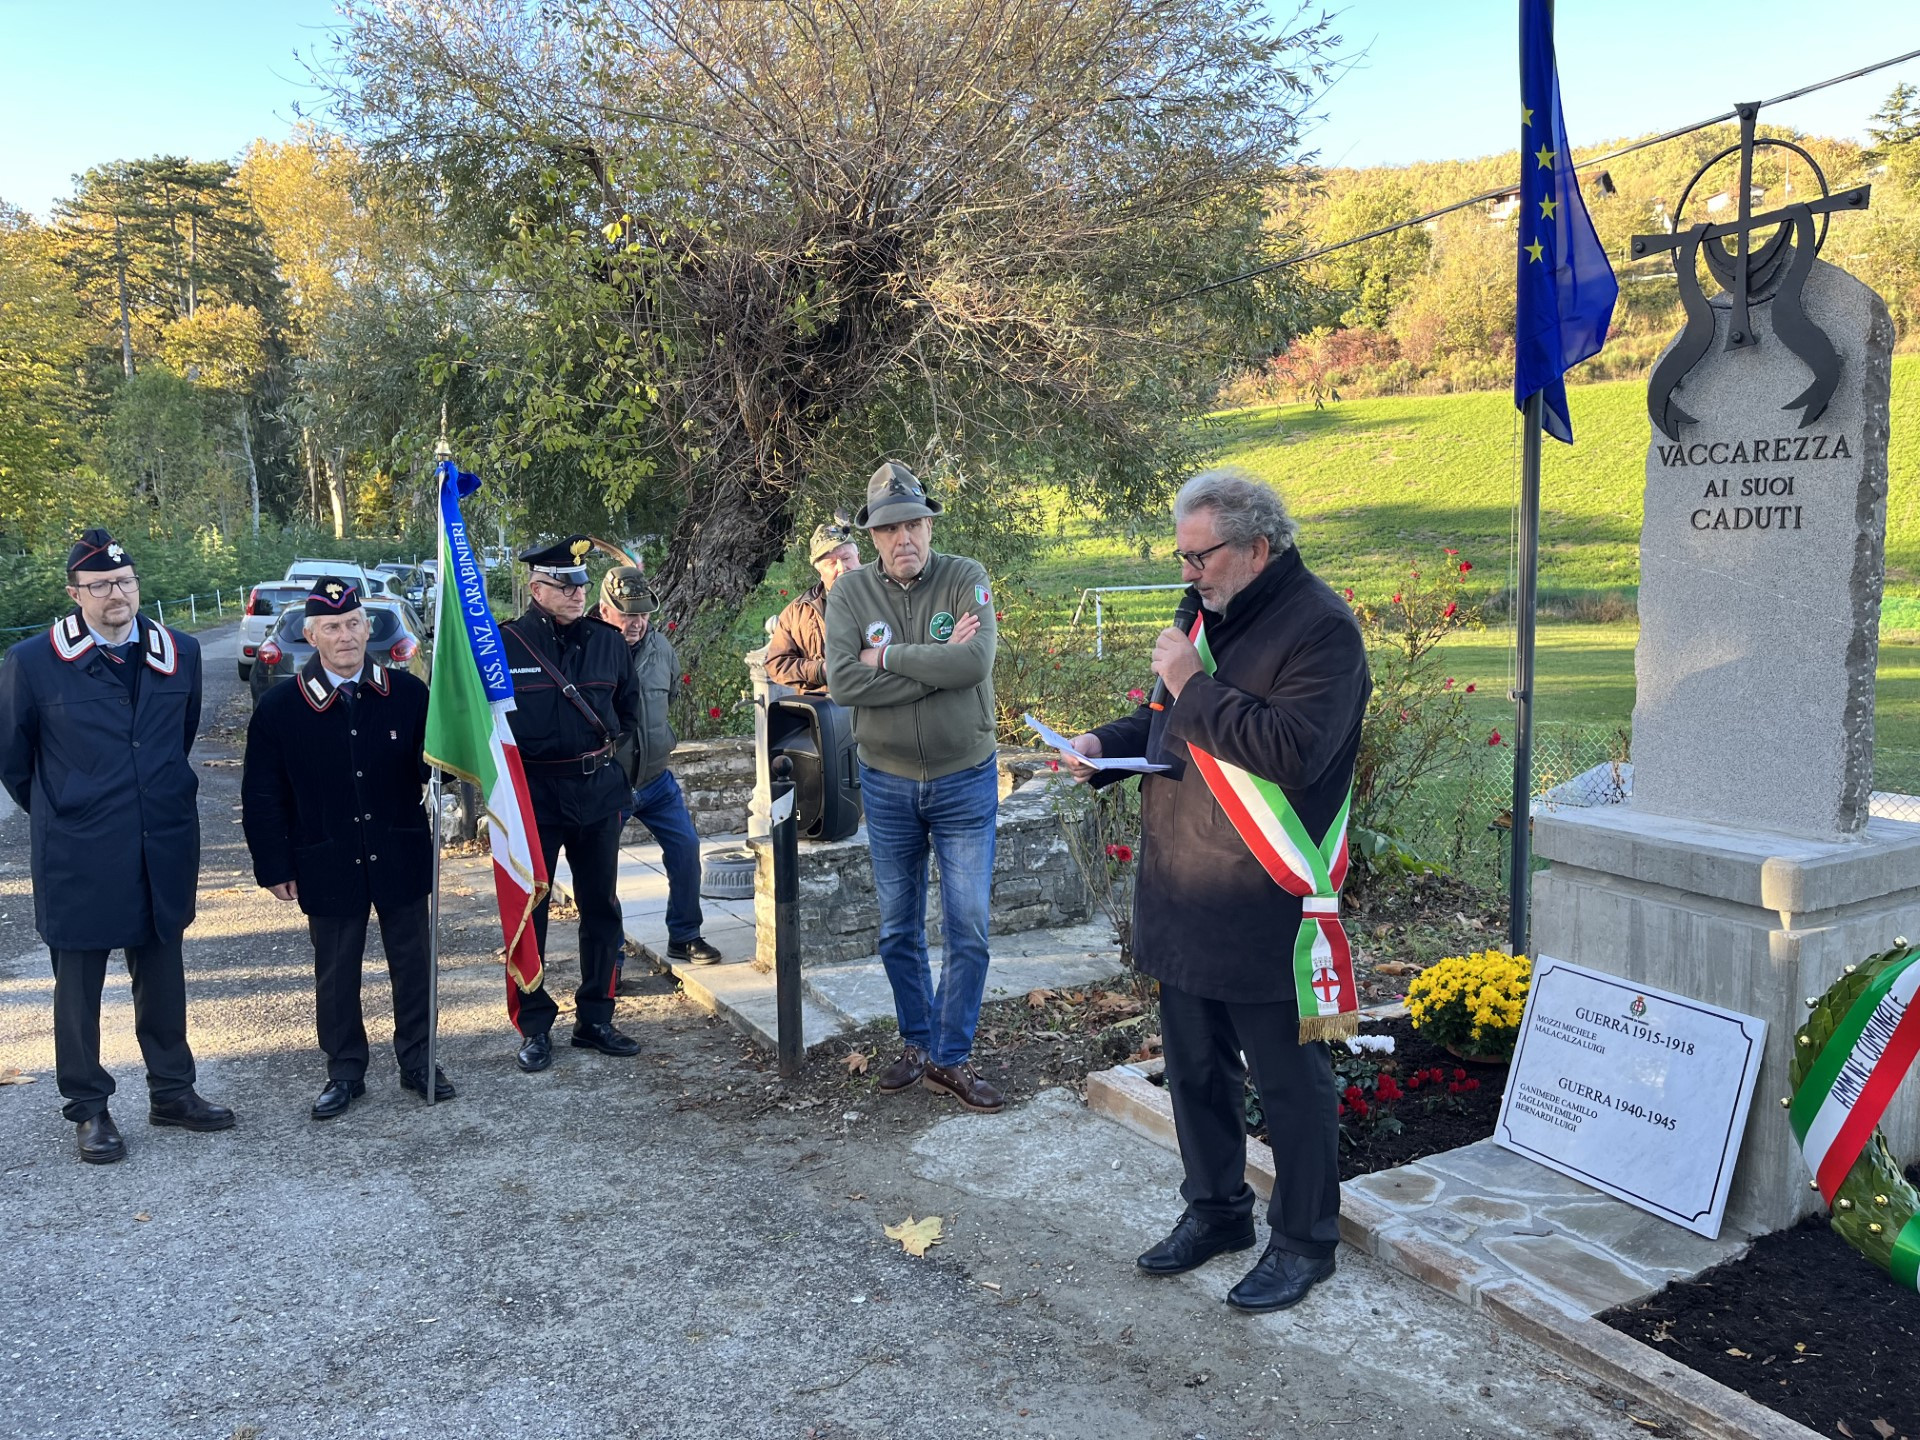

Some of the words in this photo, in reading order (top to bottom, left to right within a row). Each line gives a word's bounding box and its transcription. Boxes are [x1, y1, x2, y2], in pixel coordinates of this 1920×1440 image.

[1657, 434, 1851, 466] VACCAREZZA
[1703, 479, 1728, 498] AI
[1740, 476, 1794, 496] SUOI
[1690, 506, 1802, 530] CADUTI
[451, 522, 486, 617] CARABINIERI
[473, 619, 498, 656] NAZ.
[483, 658, 507, 689] ASS.
[1534, 1024, 1582, 1047] MALACALZA
[1583, 1040, 1606, 1055] LUIGI
[1536, 1014, 1561, 1029] MOZZI
[1562, 1024, 1598, 1041] MICHELE
[1575, 1007, 1629, 1034] GUERRA
[1632, 1025, 1695, 1056] 1915-1918
[1856, 988, 1908, 1061] COMUNALE
[1518, 1092, 1553, 1112] TAGLIANI
[1554, 1106, 1582, 1124] EMILIO
[1520, 1082, 1561, 1105] GANIMEDE
[1561, 1099, 1598, 1119] CAMILLO
[1558, 1077, 1612, 1107] GUERRA
[1615, 1098, 1677, 1131] 1940-1945
[1515, 1102, 1554, 1124] BERNARDI
[1554, 1118, 1577, 1133] LUIGI
